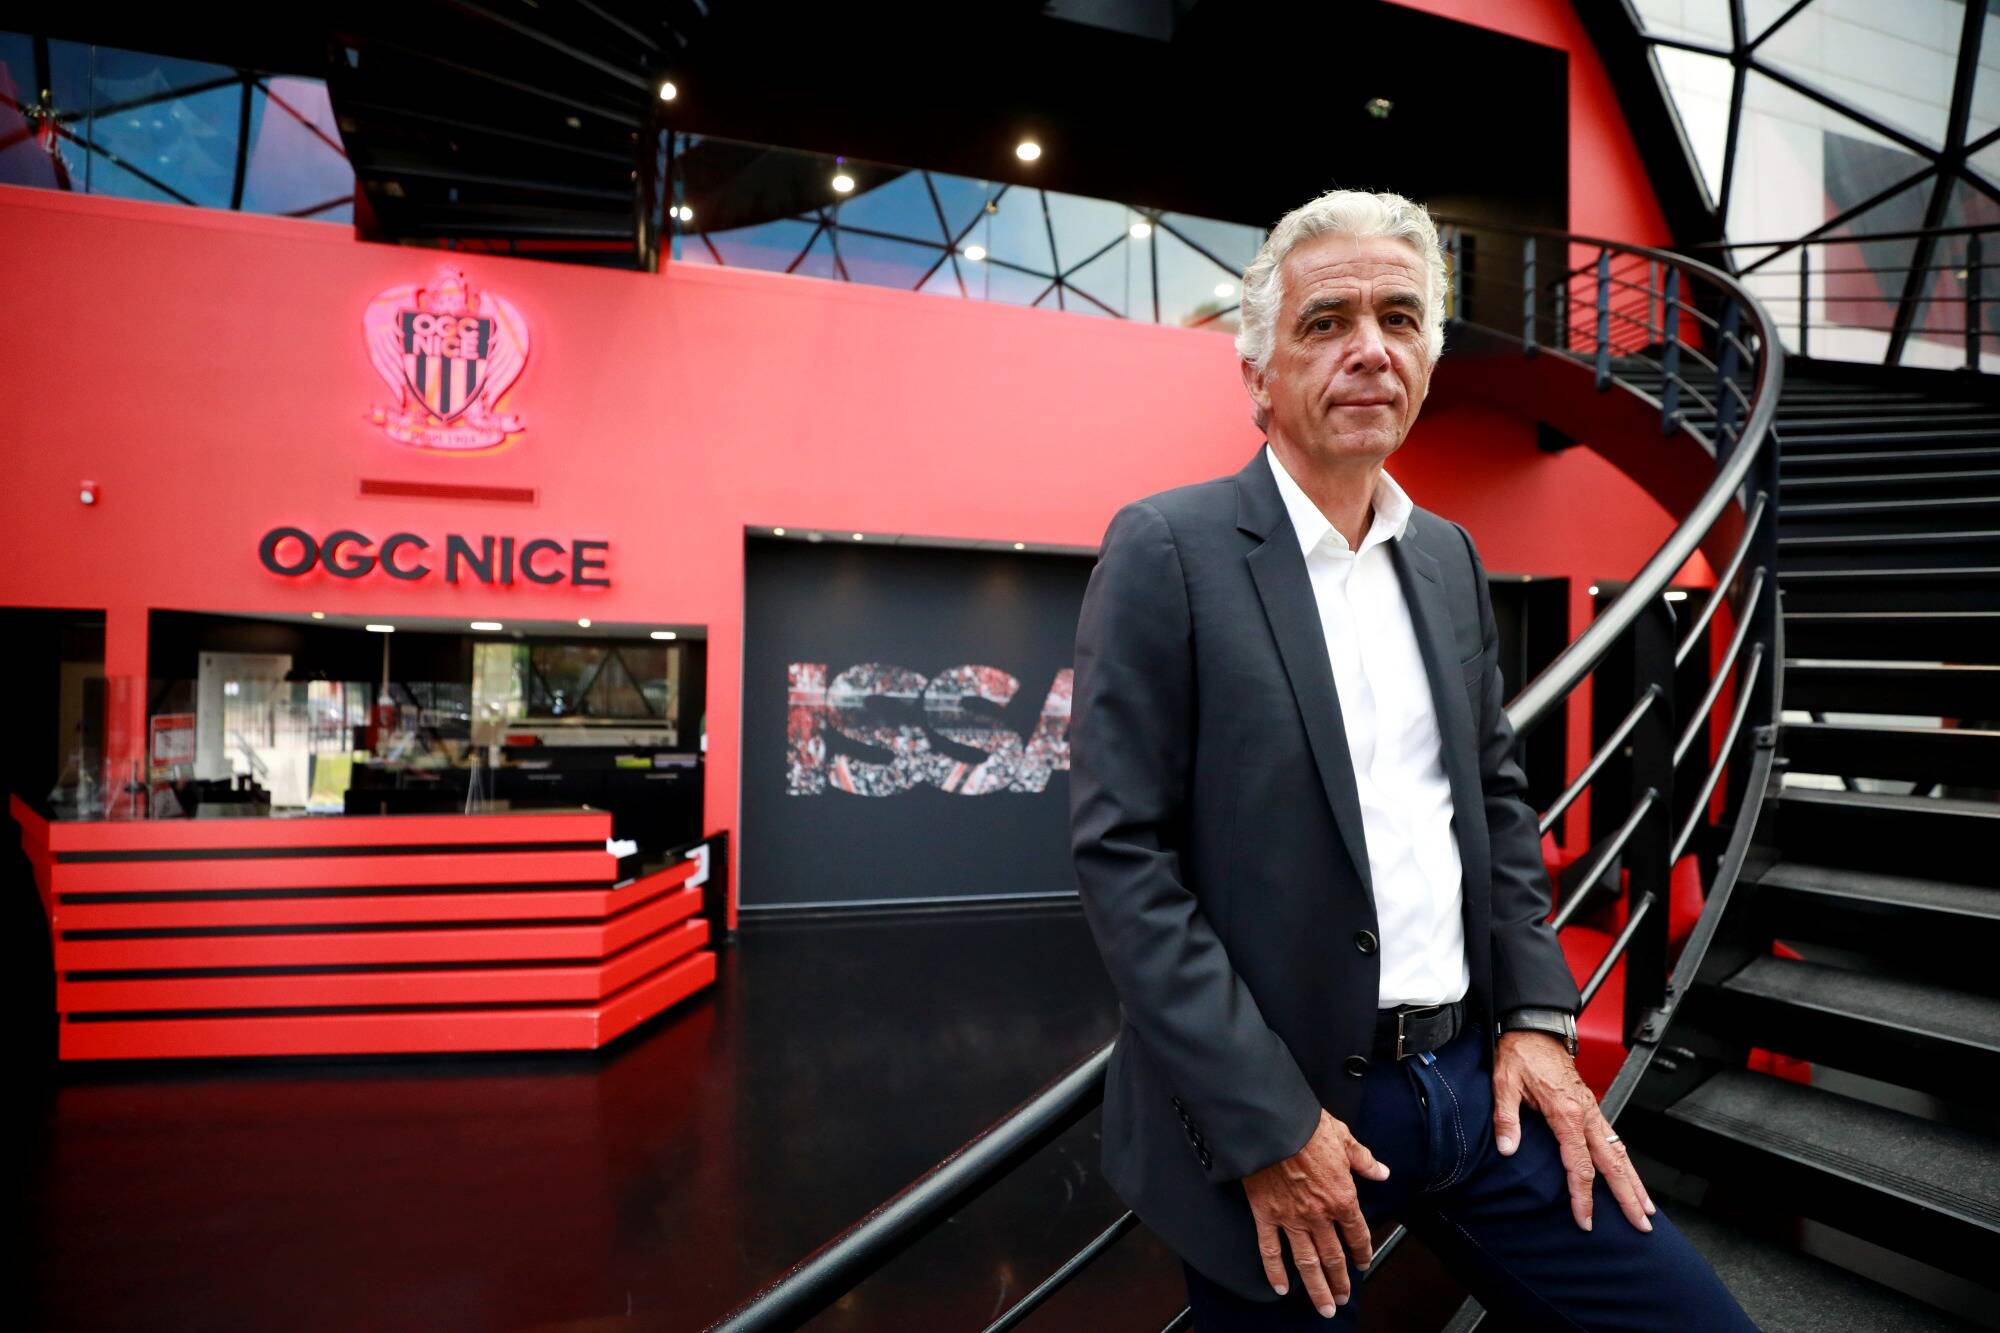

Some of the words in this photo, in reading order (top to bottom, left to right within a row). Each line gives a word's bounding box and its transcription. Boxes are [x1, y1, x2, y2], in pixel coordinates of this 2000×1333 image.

[412, 313, 480, 338] OGC
[412, 334, 480, 360] NICE
[259, 526, 431, 580] OGC
[446, 534, 611, 587] NICE
